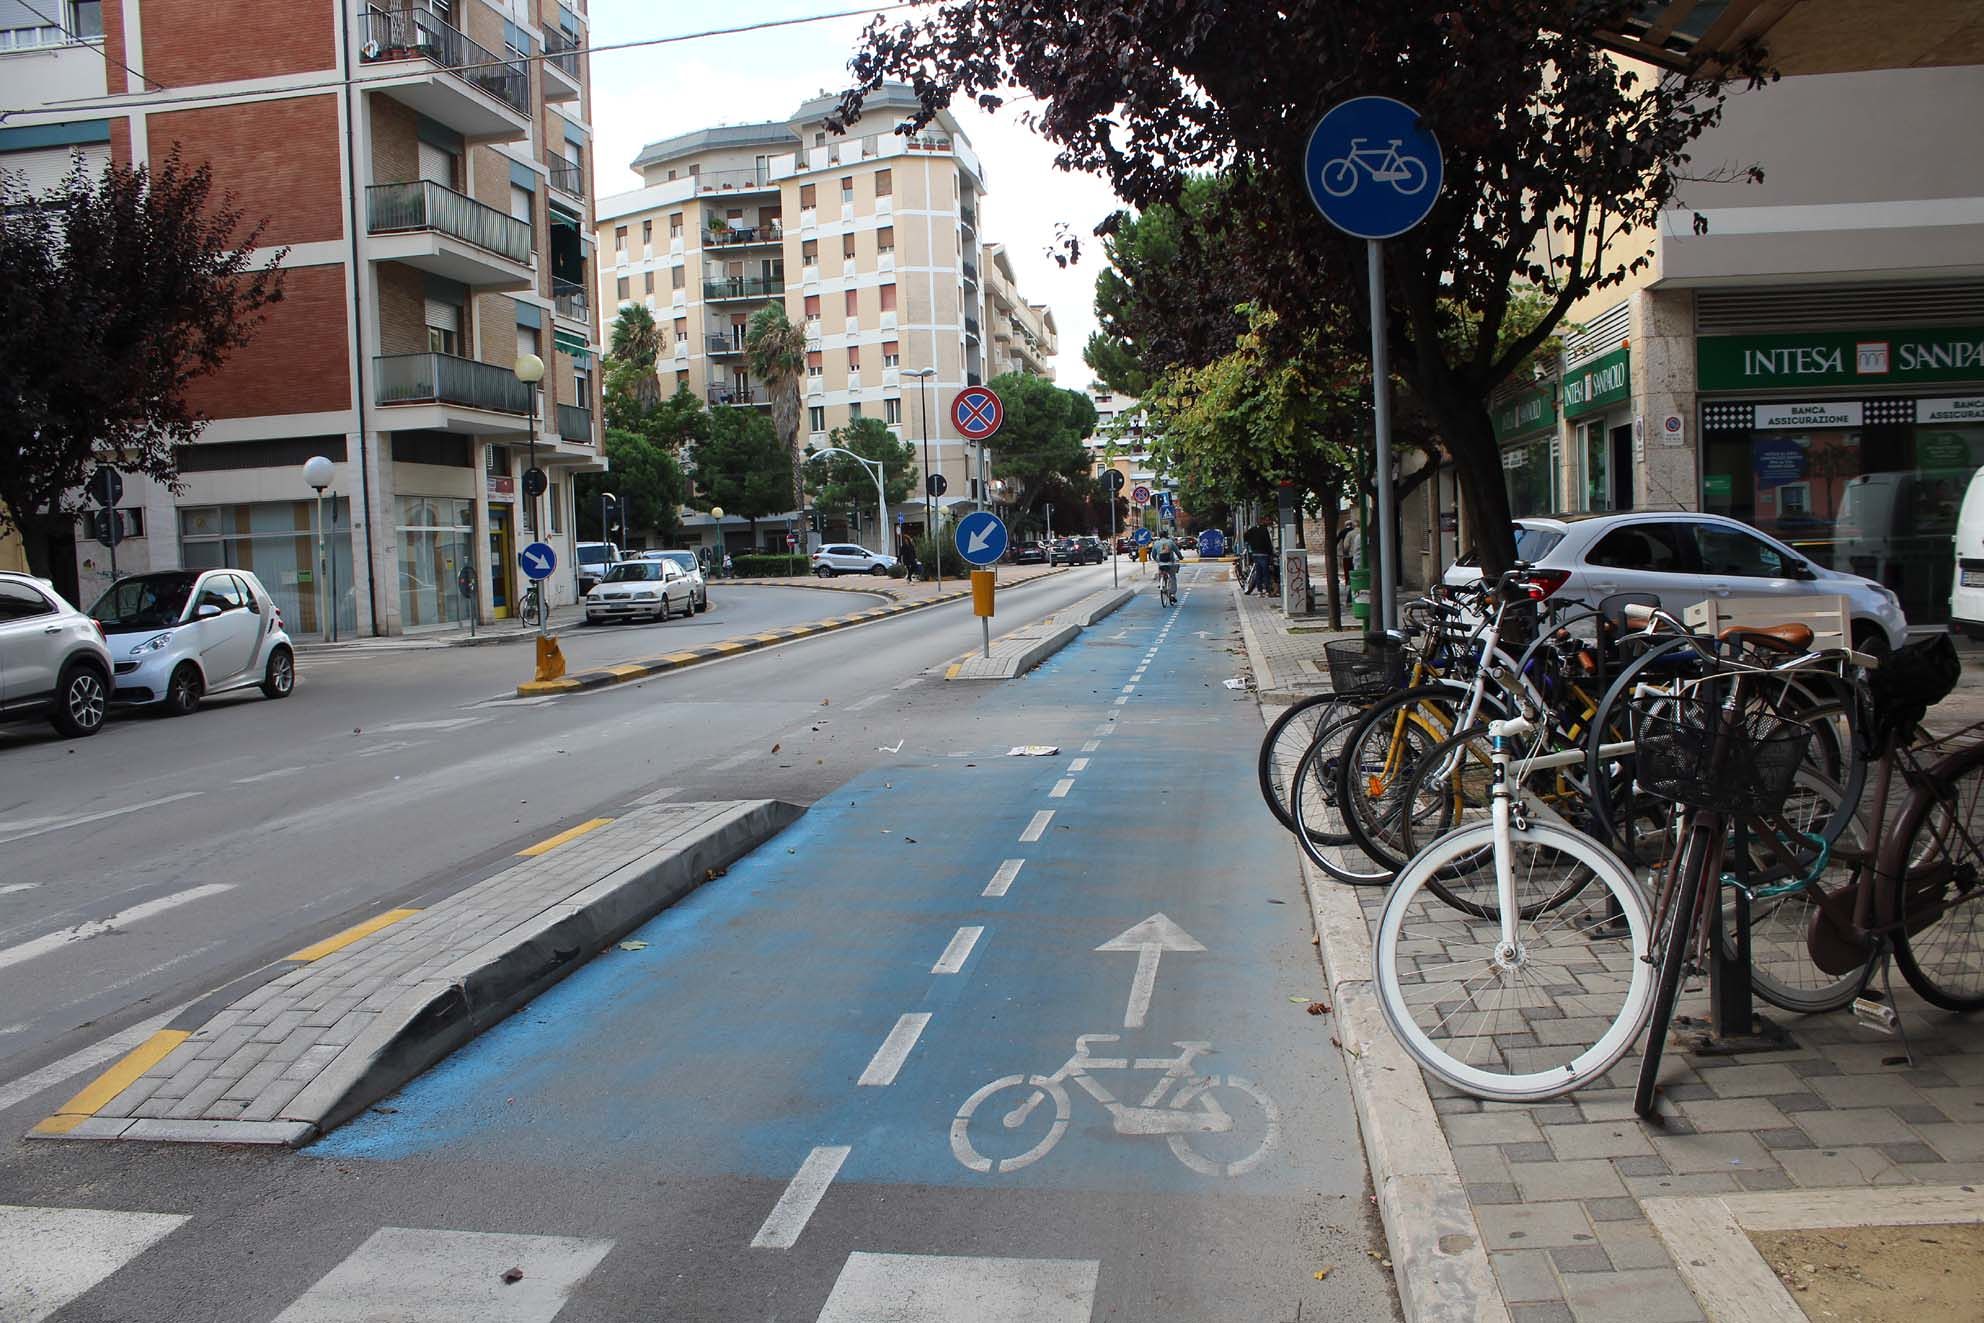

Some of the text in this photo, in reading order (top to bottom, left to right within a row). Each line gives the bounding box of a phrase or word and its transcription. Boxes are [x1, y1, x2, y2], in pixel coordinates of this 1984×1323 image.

[1744, 342, 1984, 375] INTESA SANPA
[1565, 362, 1625, 407] INTESA SANPAOLO
[1768, 415, 1849, 425] ASSICURAZIONE
[1791, 406, 1826, 415] BANCA
